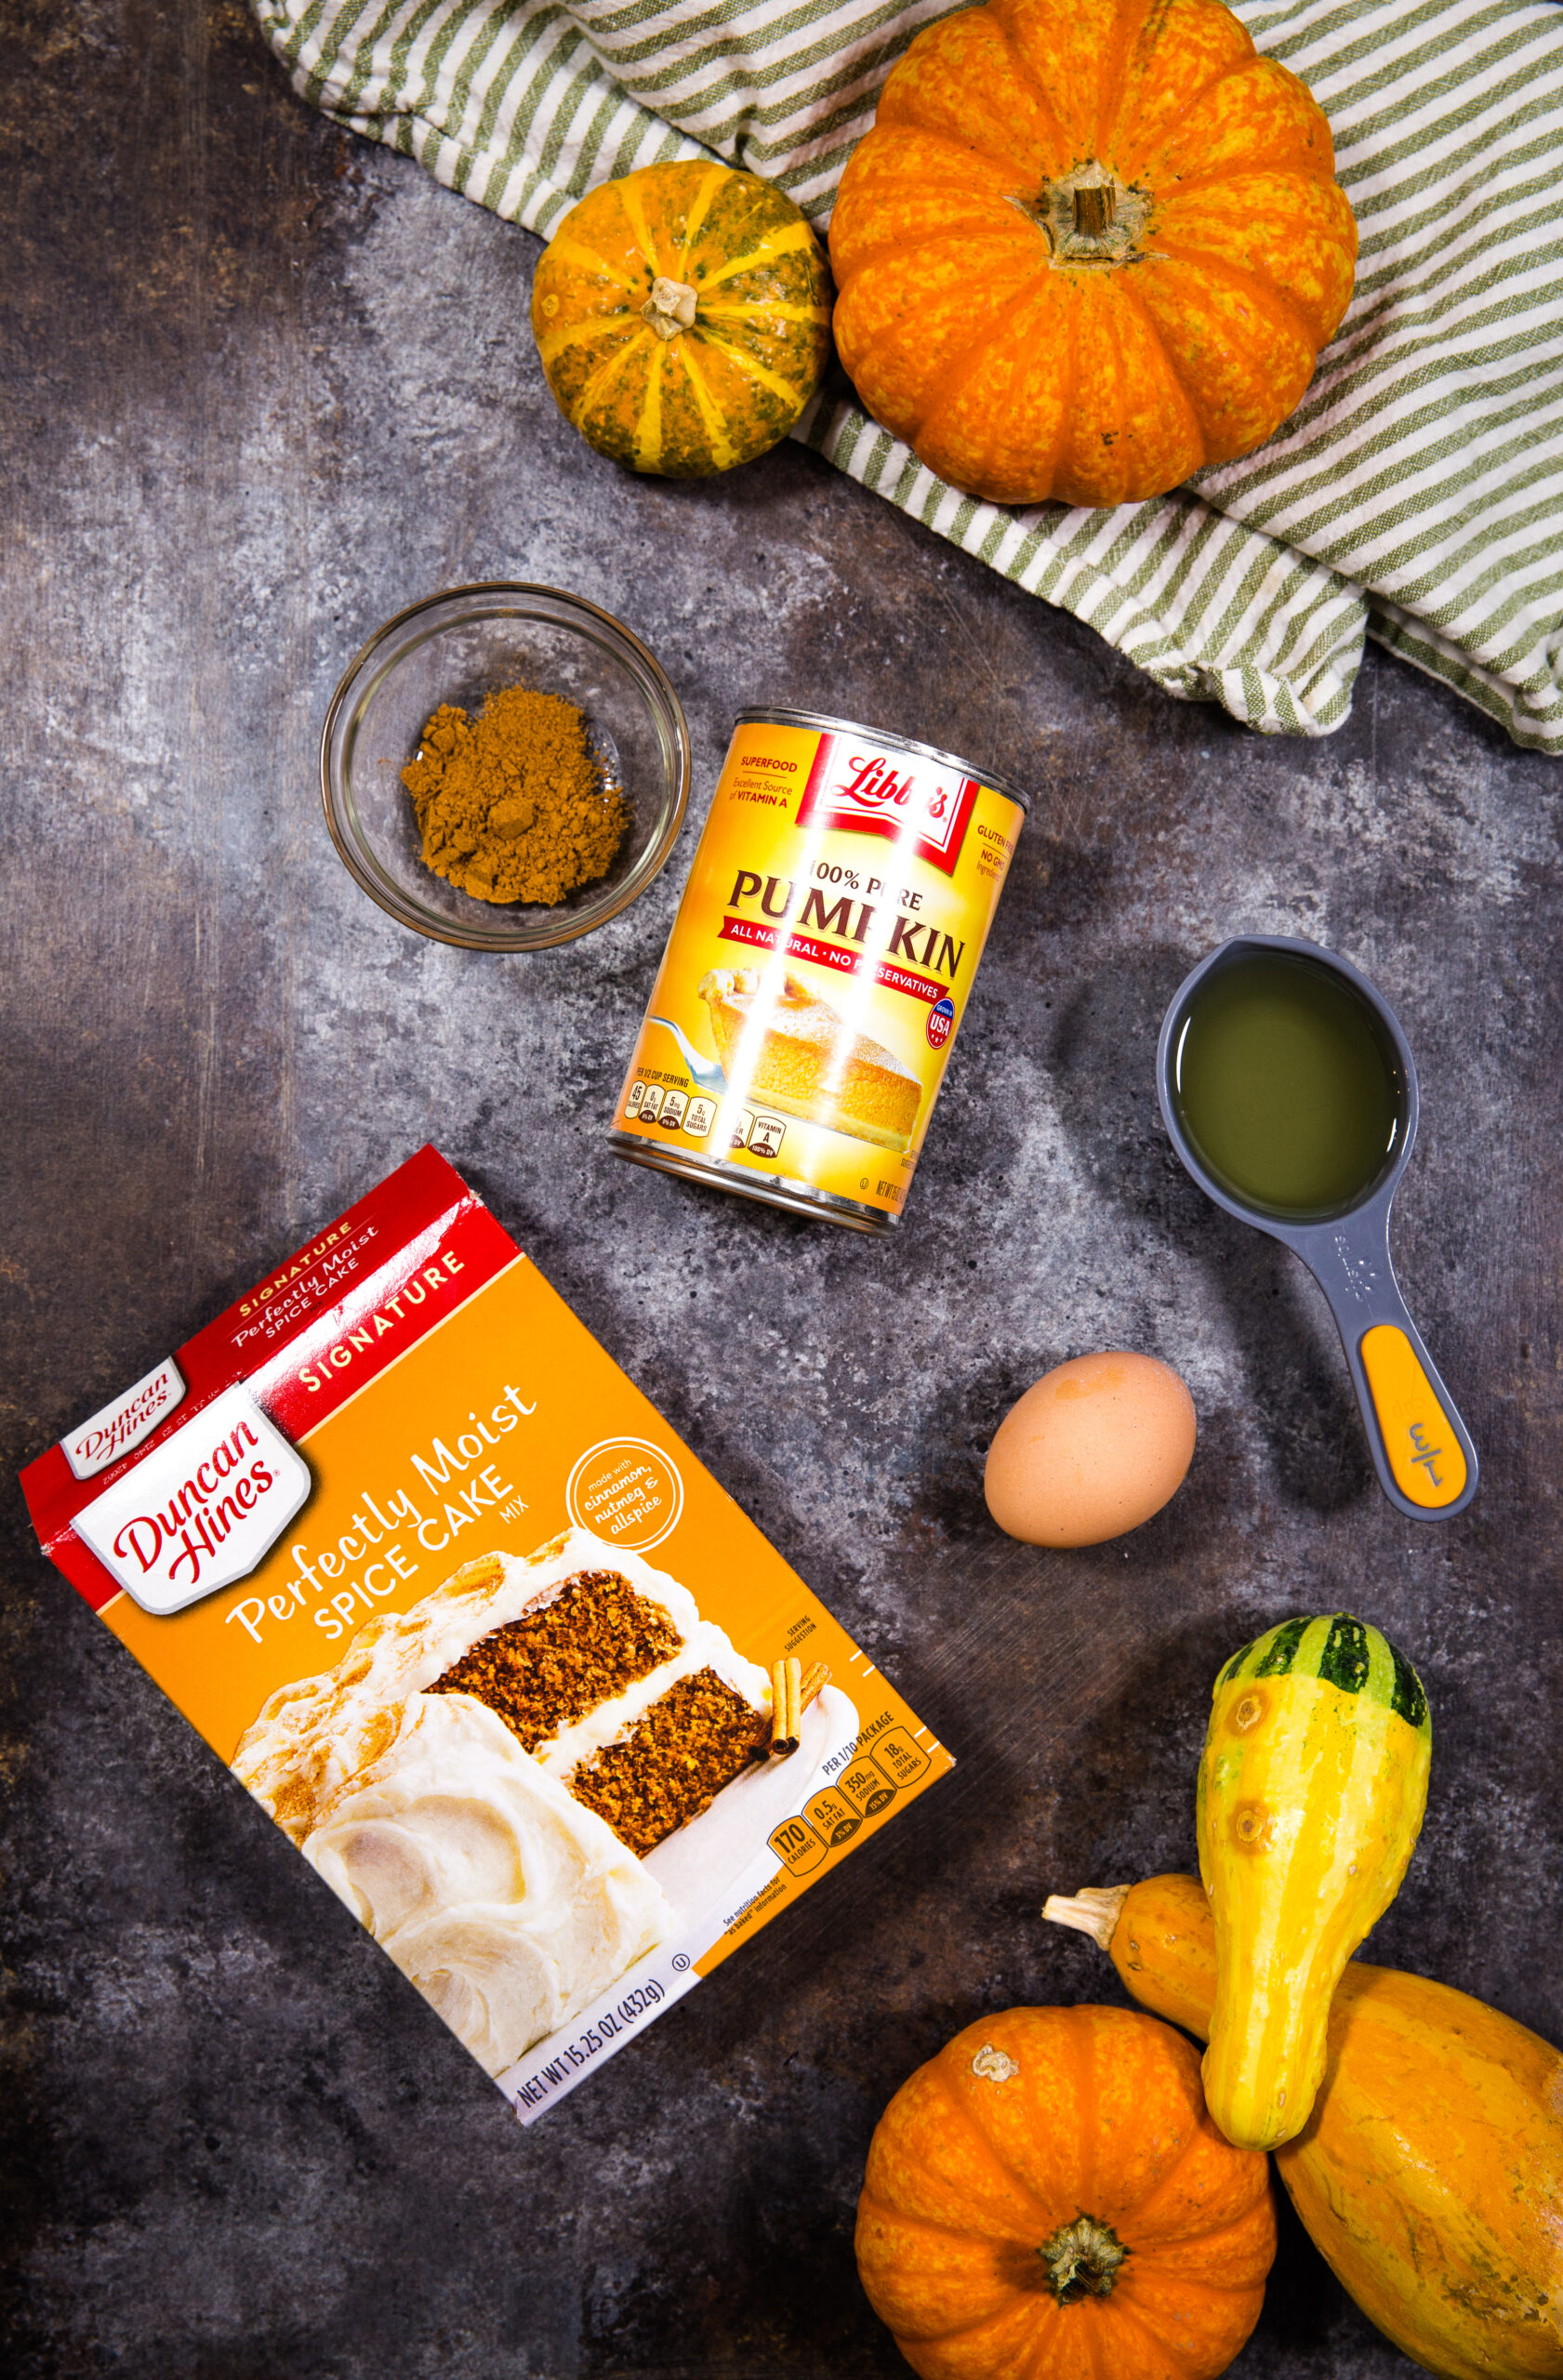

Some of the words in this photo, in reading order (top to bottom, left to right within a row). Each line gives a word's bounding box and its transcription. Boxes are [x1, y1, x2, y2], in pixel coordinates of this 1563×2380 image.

[741, 756, 798, 773] SUPERFOOD
[733, 777, 762, 790] Excellent
[763, 781, 792, 795] Source
[830, 756, 947, 818] Libb's
[730, 790, 737, 800] of
[737, 790, 777, 806] VITAMIN
[778, 798, 788, 809] A
[977, 825, 1005, 848] GLUTEN
[981, 849, 993, 863] NO
[993, 856, 1004, 871] GMO
[810, 860, 859, 890] 100%
[730, 924, 752, 939] ALL
[756, 930, 819, 958] NATURAL
[828, 950, 852, 966] NO
[854, 959, 939, 998] PSERVATIVES
[930, 1013, 950, 1037] USA
[636, 1066, 644, 1077] PER
[651, 1070, 662, 1080] CUP
[662, 1073, 689, 1088] SERVING
[628, 1100, 641, 1109] CALORIES
[632, 1085, 642, 1101] 45
[651, 1103, 659, 1111] FAT
[663, 1106, 682, 1117] SODIUM
[691, 1114, 707, 1124] TOTAL
[686, 1120, 708, 1132] SUGARS
[758, 1121, 782, 1134] VITAMIN
[762, 1131, 770, 1144] A
[751, 1145, 766, 1155] 100%
[239, 1222, 351, 1317] SIGNATURE
[231, 1276, 320, 1347] Perfectly
[322, 1225, 379, 1276] Moist
[265, 1296, 312, 1339] SPICE
[315, 1257, 359, 1297] CAKE
[310, 1301, 323, 1313] MIX
[298, 1250, 465, 1393] SIGNATURE
[75, 1373, 169, 1461] Duncan
[96, 1390, 168, 1461] Hines
[162, 1425, 173, 1437] 23
[587, 1471, 614, 1492] made
[612, 1459, 633, 1475] with
[113, 1421, 258, 1573] Duncan
[584, 1465, 652, 1512] cinnamon,
[594, 1487, 646, 1525] nutmeg
[644, 1476, 659, 1490] &
[225, 1488, 423, 1644] Perfectly
[410, 1384, 537, 1496] Moist
[498, 1494, 530, 1525] MIX
[610, 1496, 663, 1535] allspice
[168, 1460, 273, 1584] Hines
[314, 1543, 419, 1640] SPICE
[417, 1463, 514, 1552] CAKE
[784, 1621, 817, 1652] SUGGESTION
[787, 1615, 812, 1637] SERVING
[822, 1757, 841, 1777] PER
[838, 1741, 859, 1762] 1/10
[855, 1711, 894, 1747] PACKAGE
[883, 1742, 905, 1759] 18g
[893, 1752, 913, 1769] TOTAL
[896, 1756, 922, 1780] SUGARS
[844, 1770, 876, 1793] 350mg
[855, 1778, 881, 1802] SODIUM
[814, 1800, 838, 1820] 0.5g
[868, 1799, 881, 1811] 15%
[878, 1792, 889, 1803] DV
[822, 1818, 836, 1831] SAT
[832, 1807, 846, 1821] FAT
[842, 1821, 854, 1832] DV
[774, 1823, 806, 1854] 170
[787, 1837, 816, 1865] CALORIES
[722, 1915, 736, 1927] See
[734, 1895, 760, 1918] nutrition
[756, 1884, 773, 1897] facts
[770, 1876, 781, 1886] for
[734, 1909, 753, 1930] baked"
[754, 1884, 788, 1913] information
[516, 2074, 549, 2109] NET
[541, 2056, 570, 2086] WT
[563, 2029, 603, 2068] 15.25
[597, 2013, 623, 2039] OZ
[616, 1978, 666, 2024] (432g)
